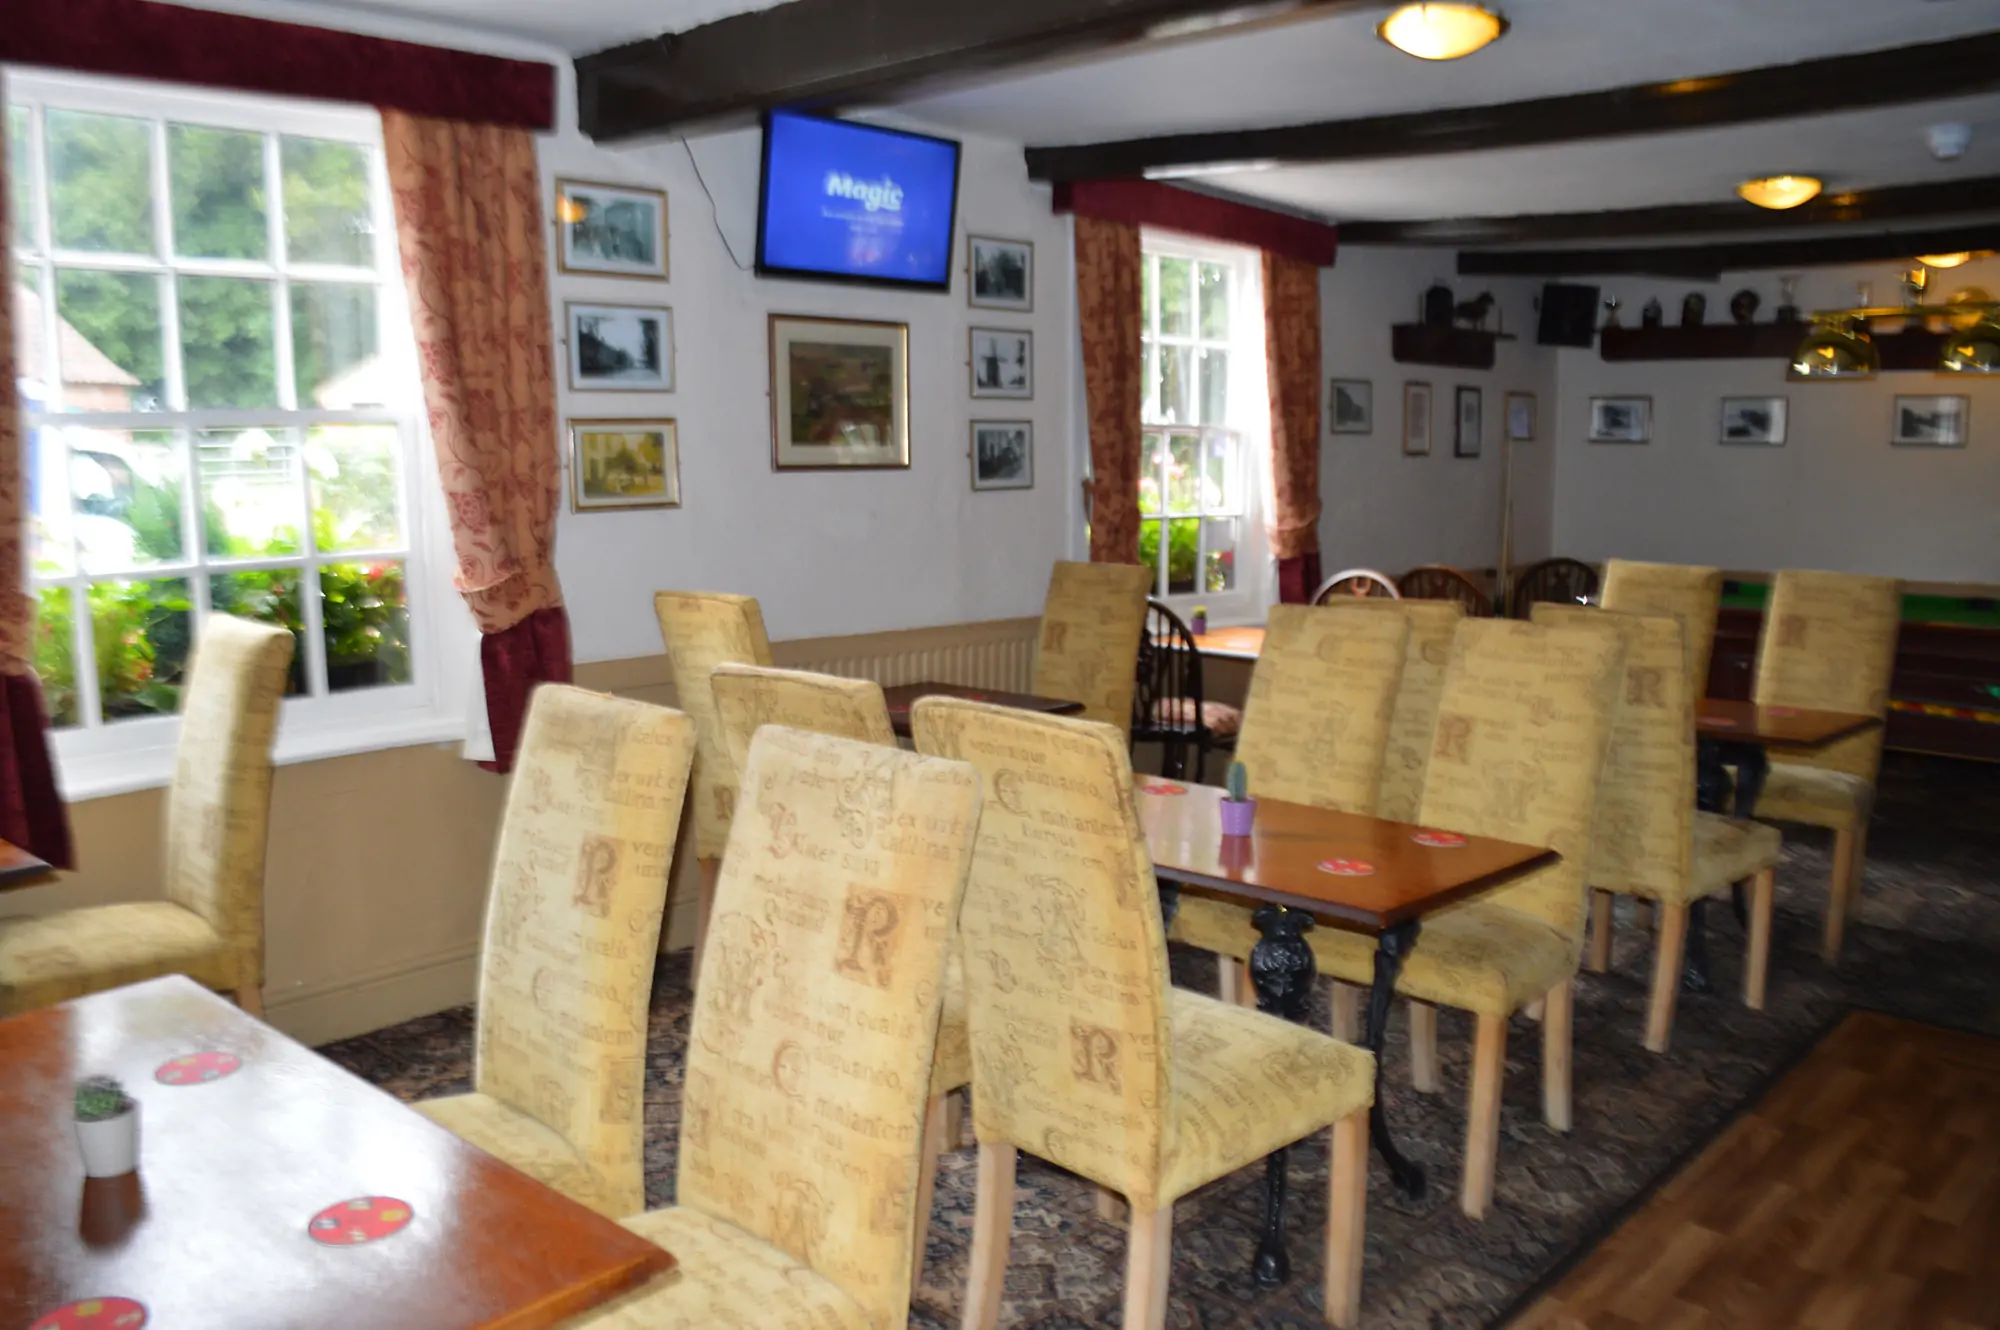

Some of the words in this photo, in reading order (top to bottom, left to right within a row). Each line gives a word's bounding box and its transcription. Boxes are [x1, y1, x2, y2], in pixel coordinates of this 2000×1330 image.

[826, 171, 904, 212] Magic
[571, 832, 625, 919] R
[836, 886, 908, 988] R
[1070, 1018, 1123, 1095] R
